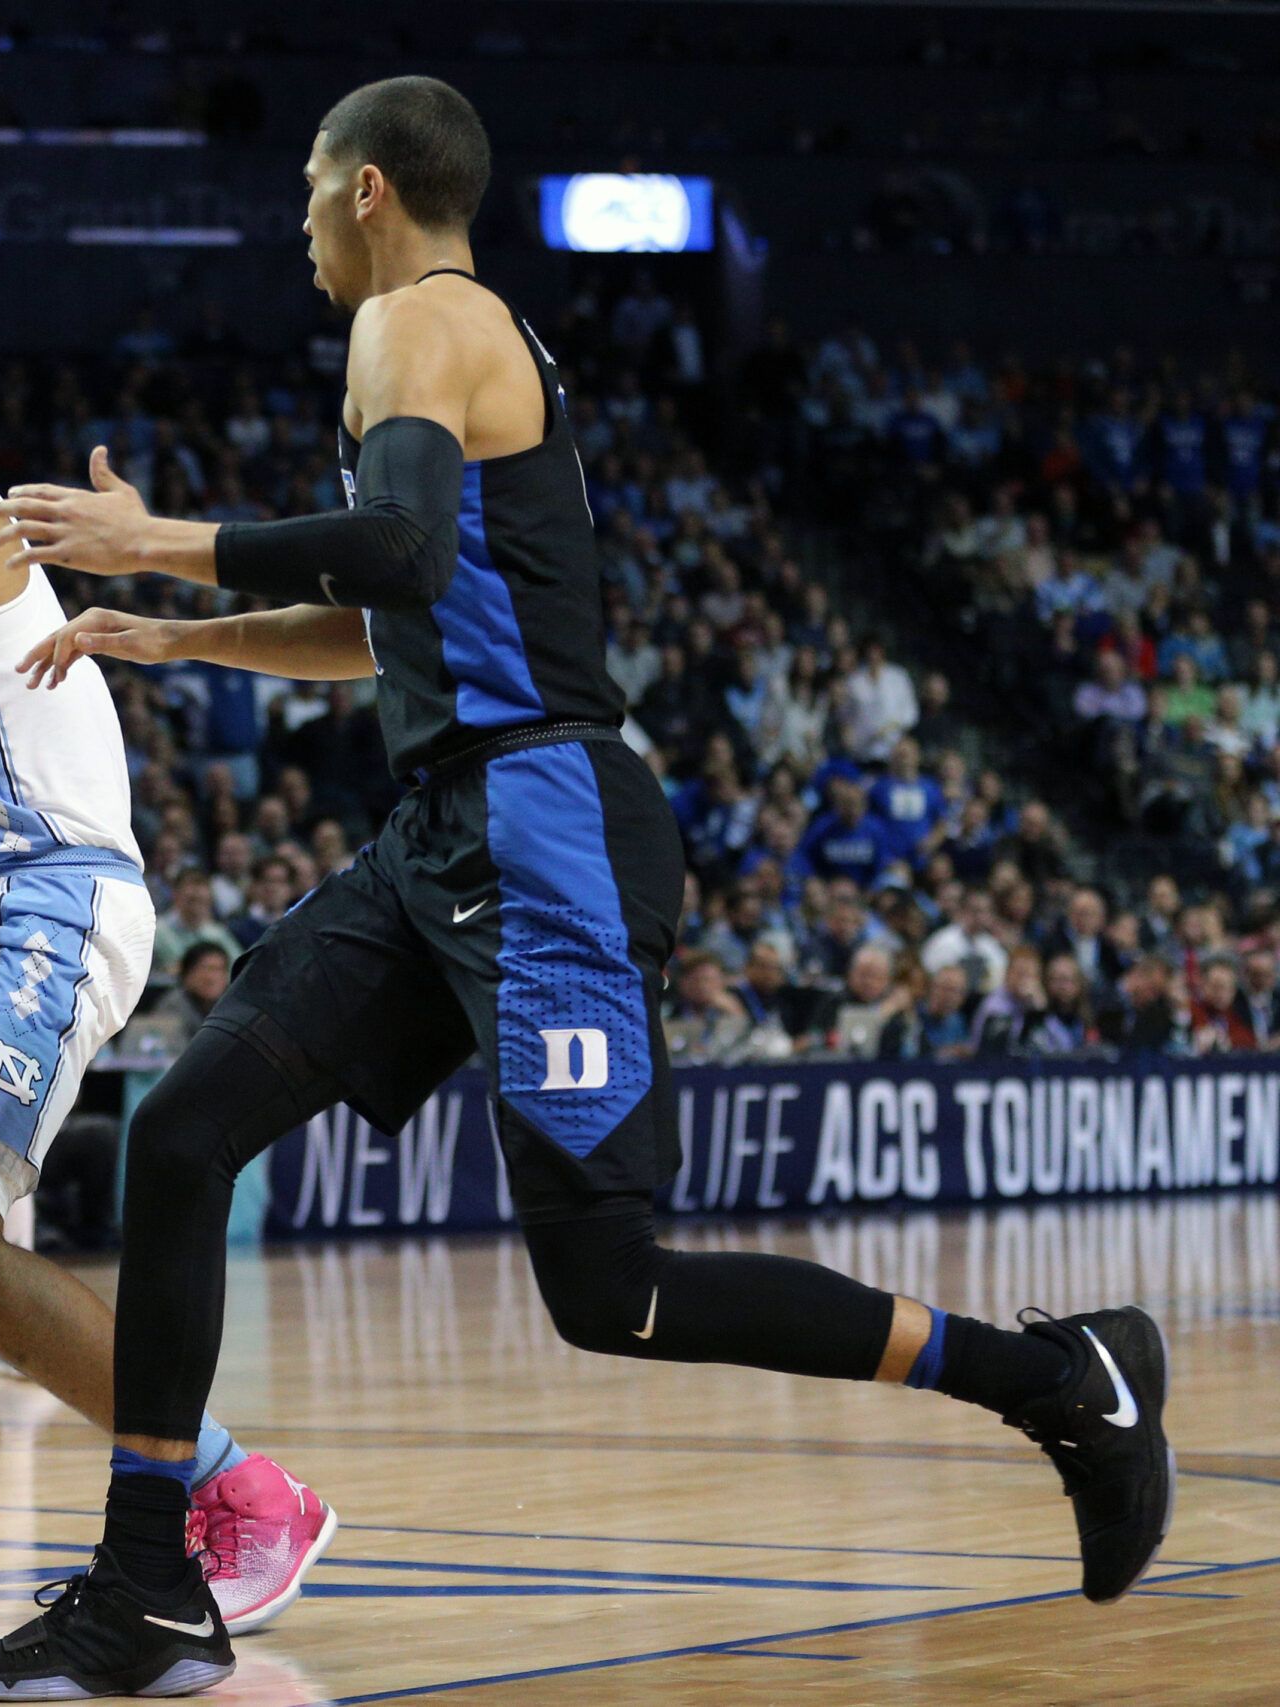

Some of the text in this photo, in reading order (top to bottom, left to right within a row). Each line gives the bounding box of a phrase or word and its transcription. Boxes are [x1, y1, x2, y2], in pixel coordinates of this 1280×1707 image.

[539, 1029, 608, 1091] D
[292, 1092, 463, 1229] NEW
[671, 1083, 801, 1210] LIFE
[808, 1079, 940, 1205] ACC
